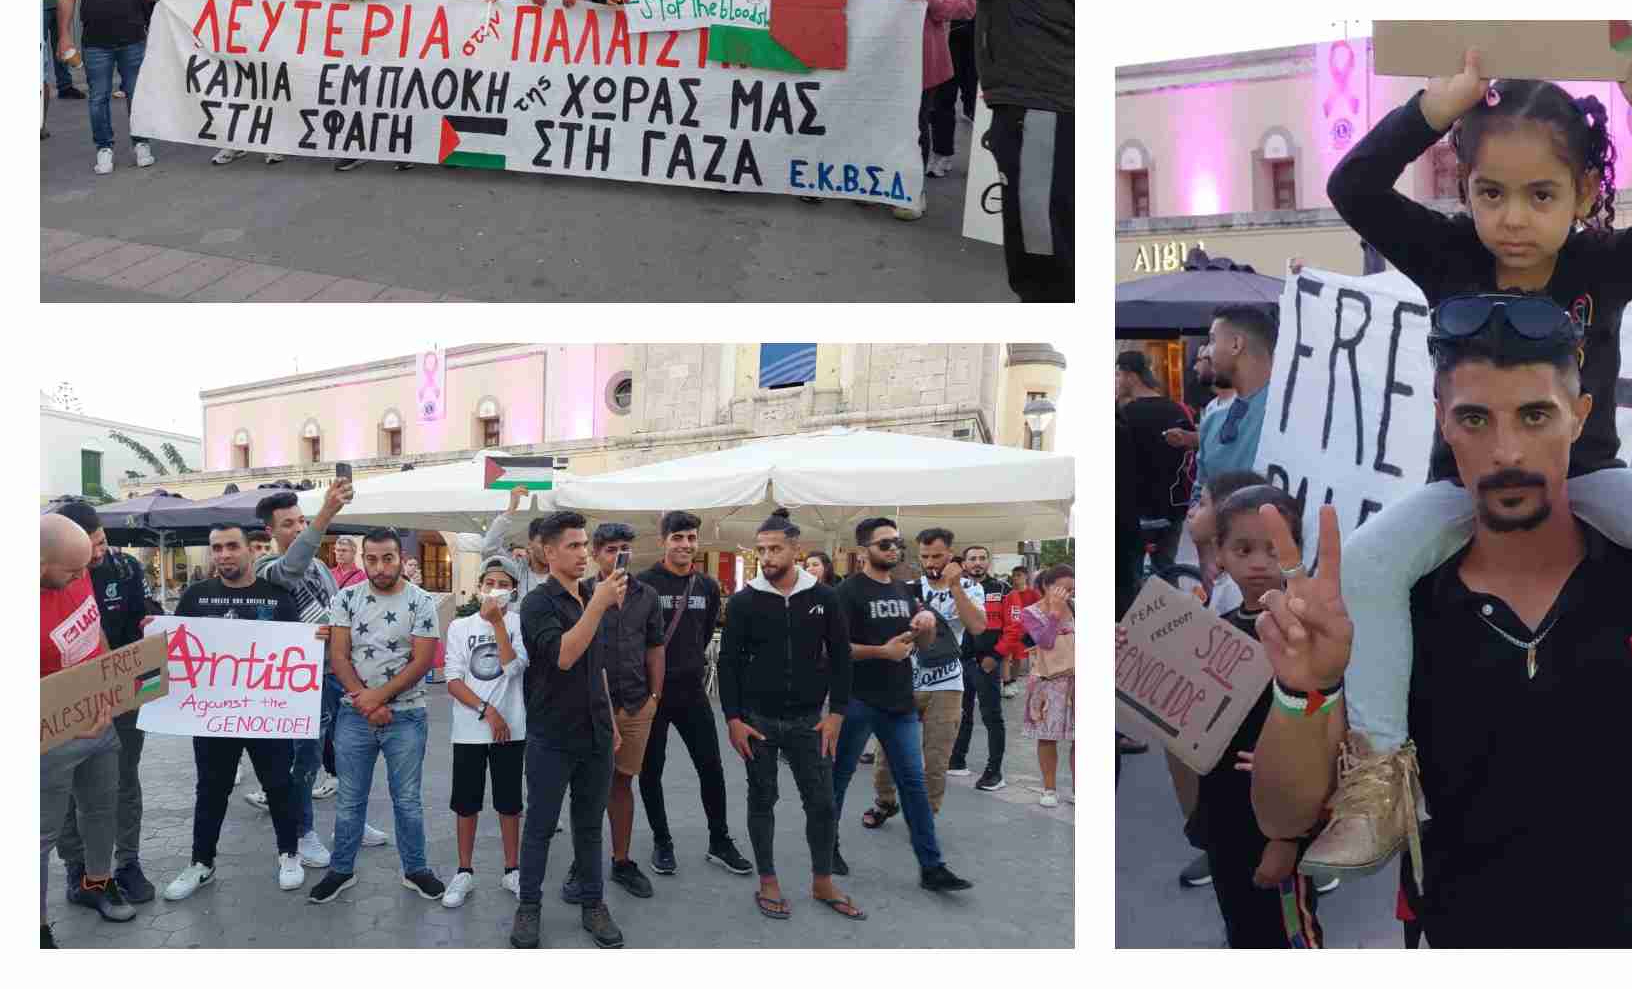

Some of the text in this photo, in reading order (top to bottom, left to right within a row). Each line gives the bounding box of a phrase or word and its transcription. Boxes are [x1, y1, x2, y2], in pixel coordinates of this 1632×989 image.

[186, 54, 827, 136] ΚΑΜΙΑ ΕΜΠΛΟΚΗ της ΧΩΡΑΣ ΜΑΣ
[198, 100, 763, 186] ΣΤΗ ΣΦΑΓΗ ΣΤΗ ΓΑΖΑ
[868, 598, 911, 619] ICON
[168, 623, 320, 693] Antifa
[1194, 625, 1255, 679] STOP
[180, 694, 288, 717] Against the
[206, 715, 312, 734] GENOCIDE!
